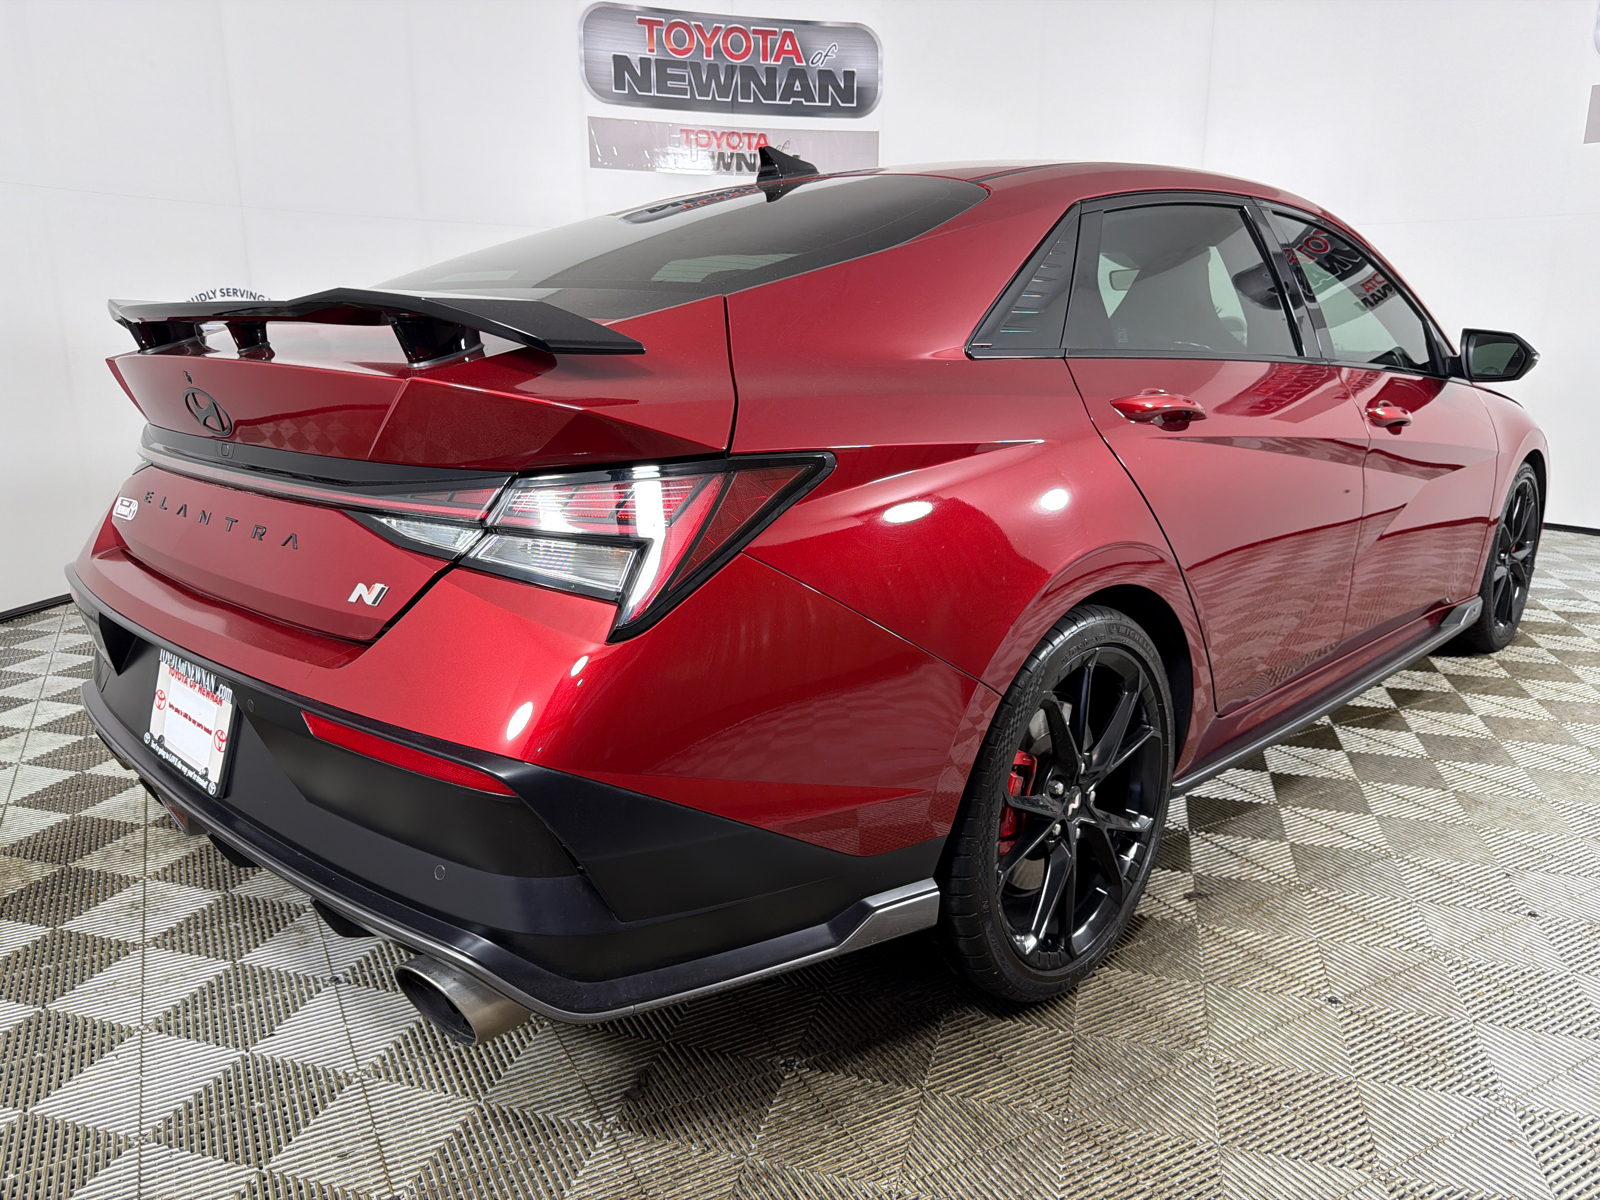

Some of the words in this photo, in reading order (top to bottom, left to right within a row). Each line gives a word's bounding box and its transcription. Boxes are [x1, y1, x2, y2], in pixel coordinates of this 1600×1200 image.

[636, 16, 806, 65] TOYOTA
[809, 42, 838, 67] of
[611, 53, 857, 107] NEWNAN
[680, 128, 769, 150] TOYOTA
[219, 287, 266, 301] SERVING
[143, 490, 298, 550] ELANTRA
[168, 667, 188, 685] TOYOTA
